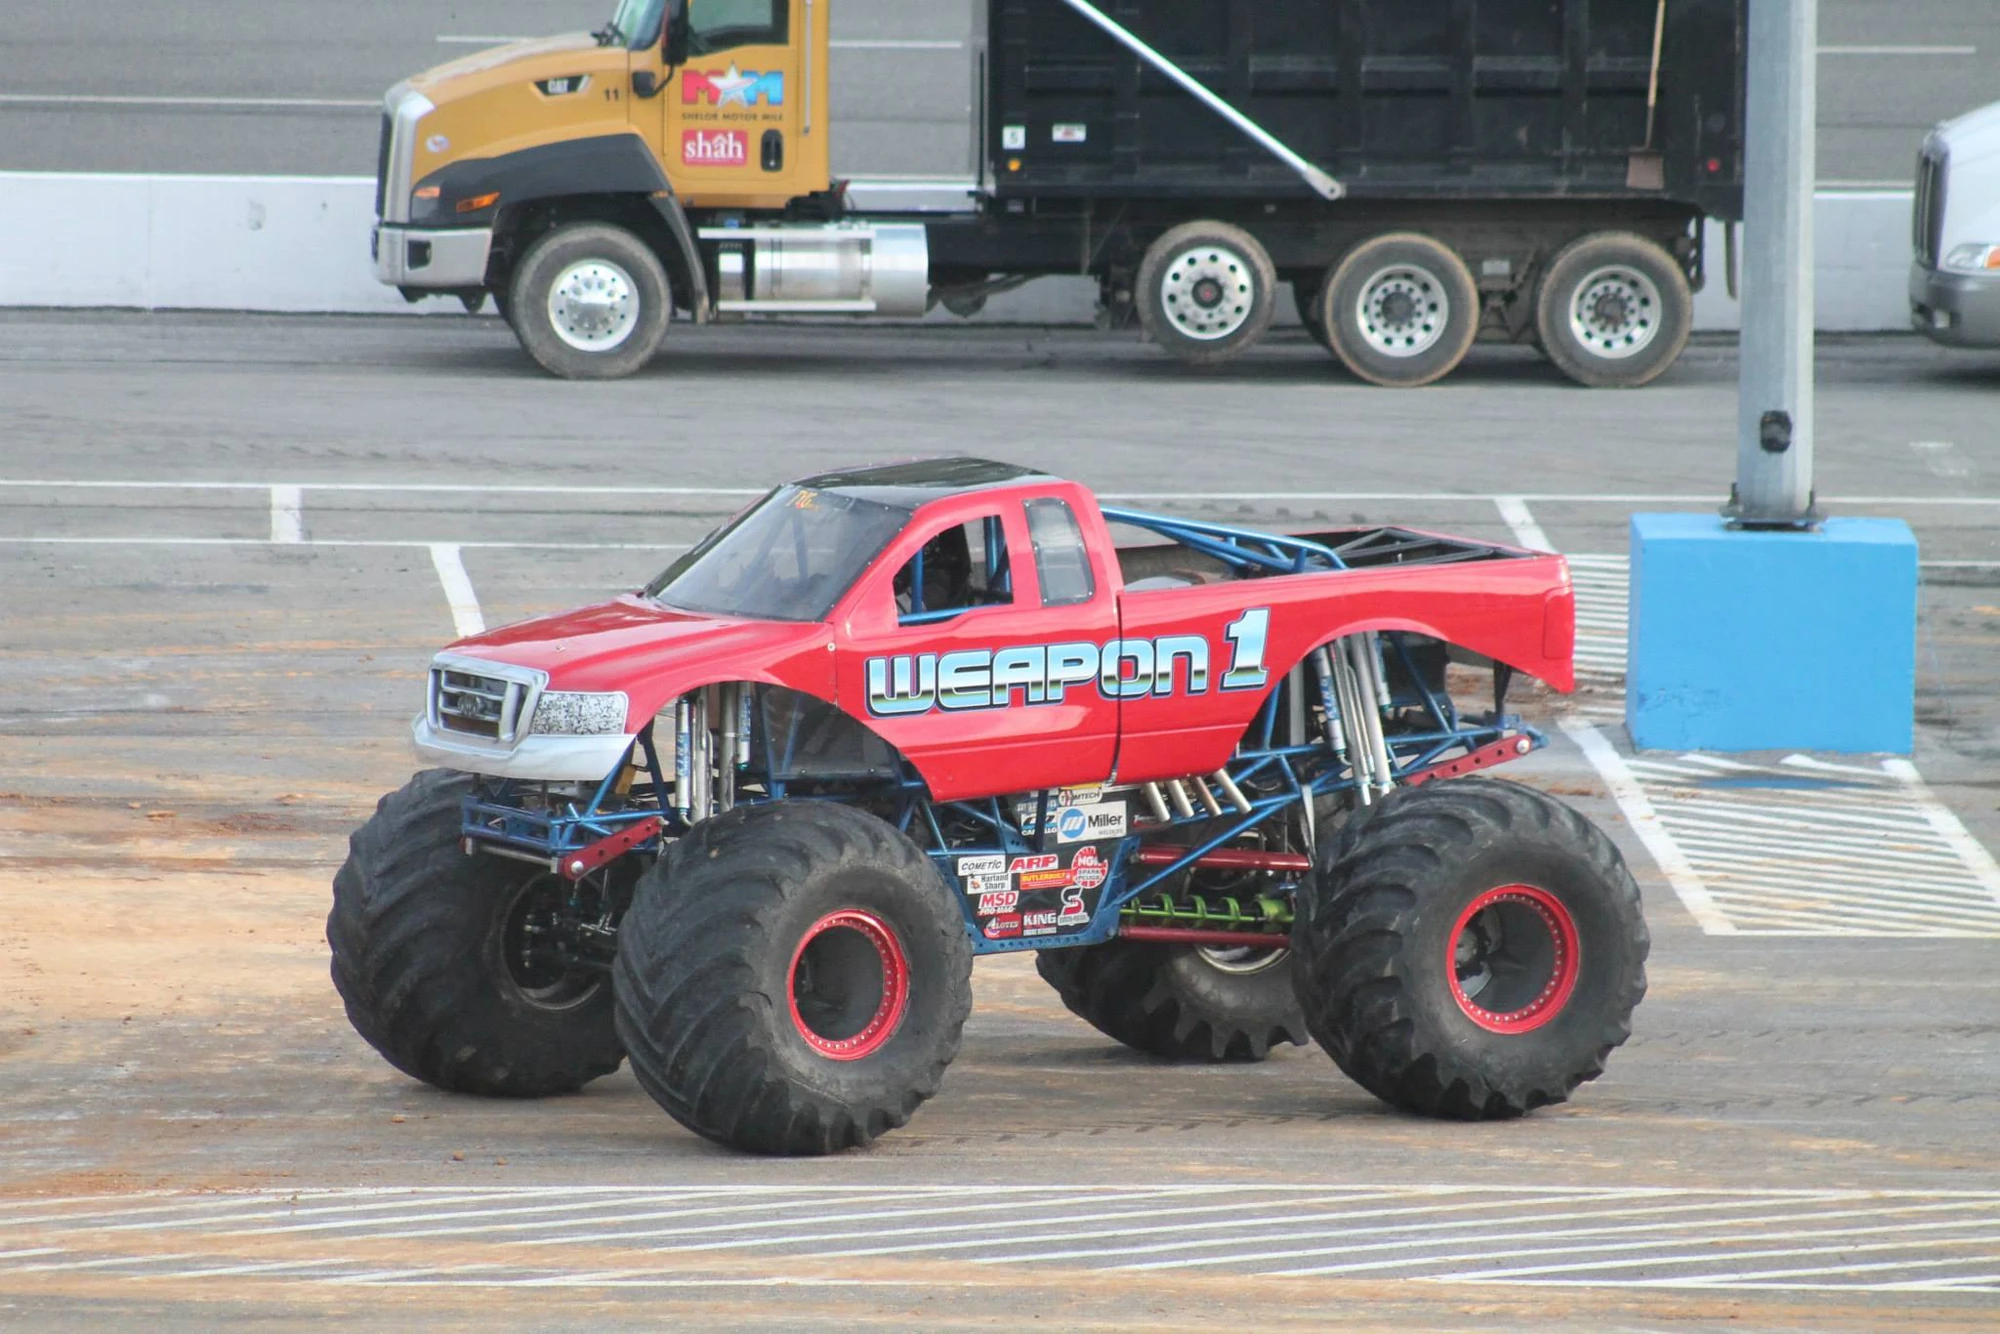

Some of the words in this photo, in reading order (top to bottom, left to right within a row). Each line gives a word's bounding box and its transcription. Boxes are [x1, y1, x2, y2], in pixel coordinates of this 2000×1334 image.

[548, 79, 569, 94] CAT
[604, 88, 619, 101] 11
[866, 635, 1209, 718] WEAPON
[1219, 607, 1271, 693] 1
[1088, 814, 1123, 828] Miller
[962, 860, 1002, 871] COMETIC
[1011, 856, 1056, 871] ARP
[980, 892, 1017, 908] MSD
[1023, 913, 1057, 926] KING
